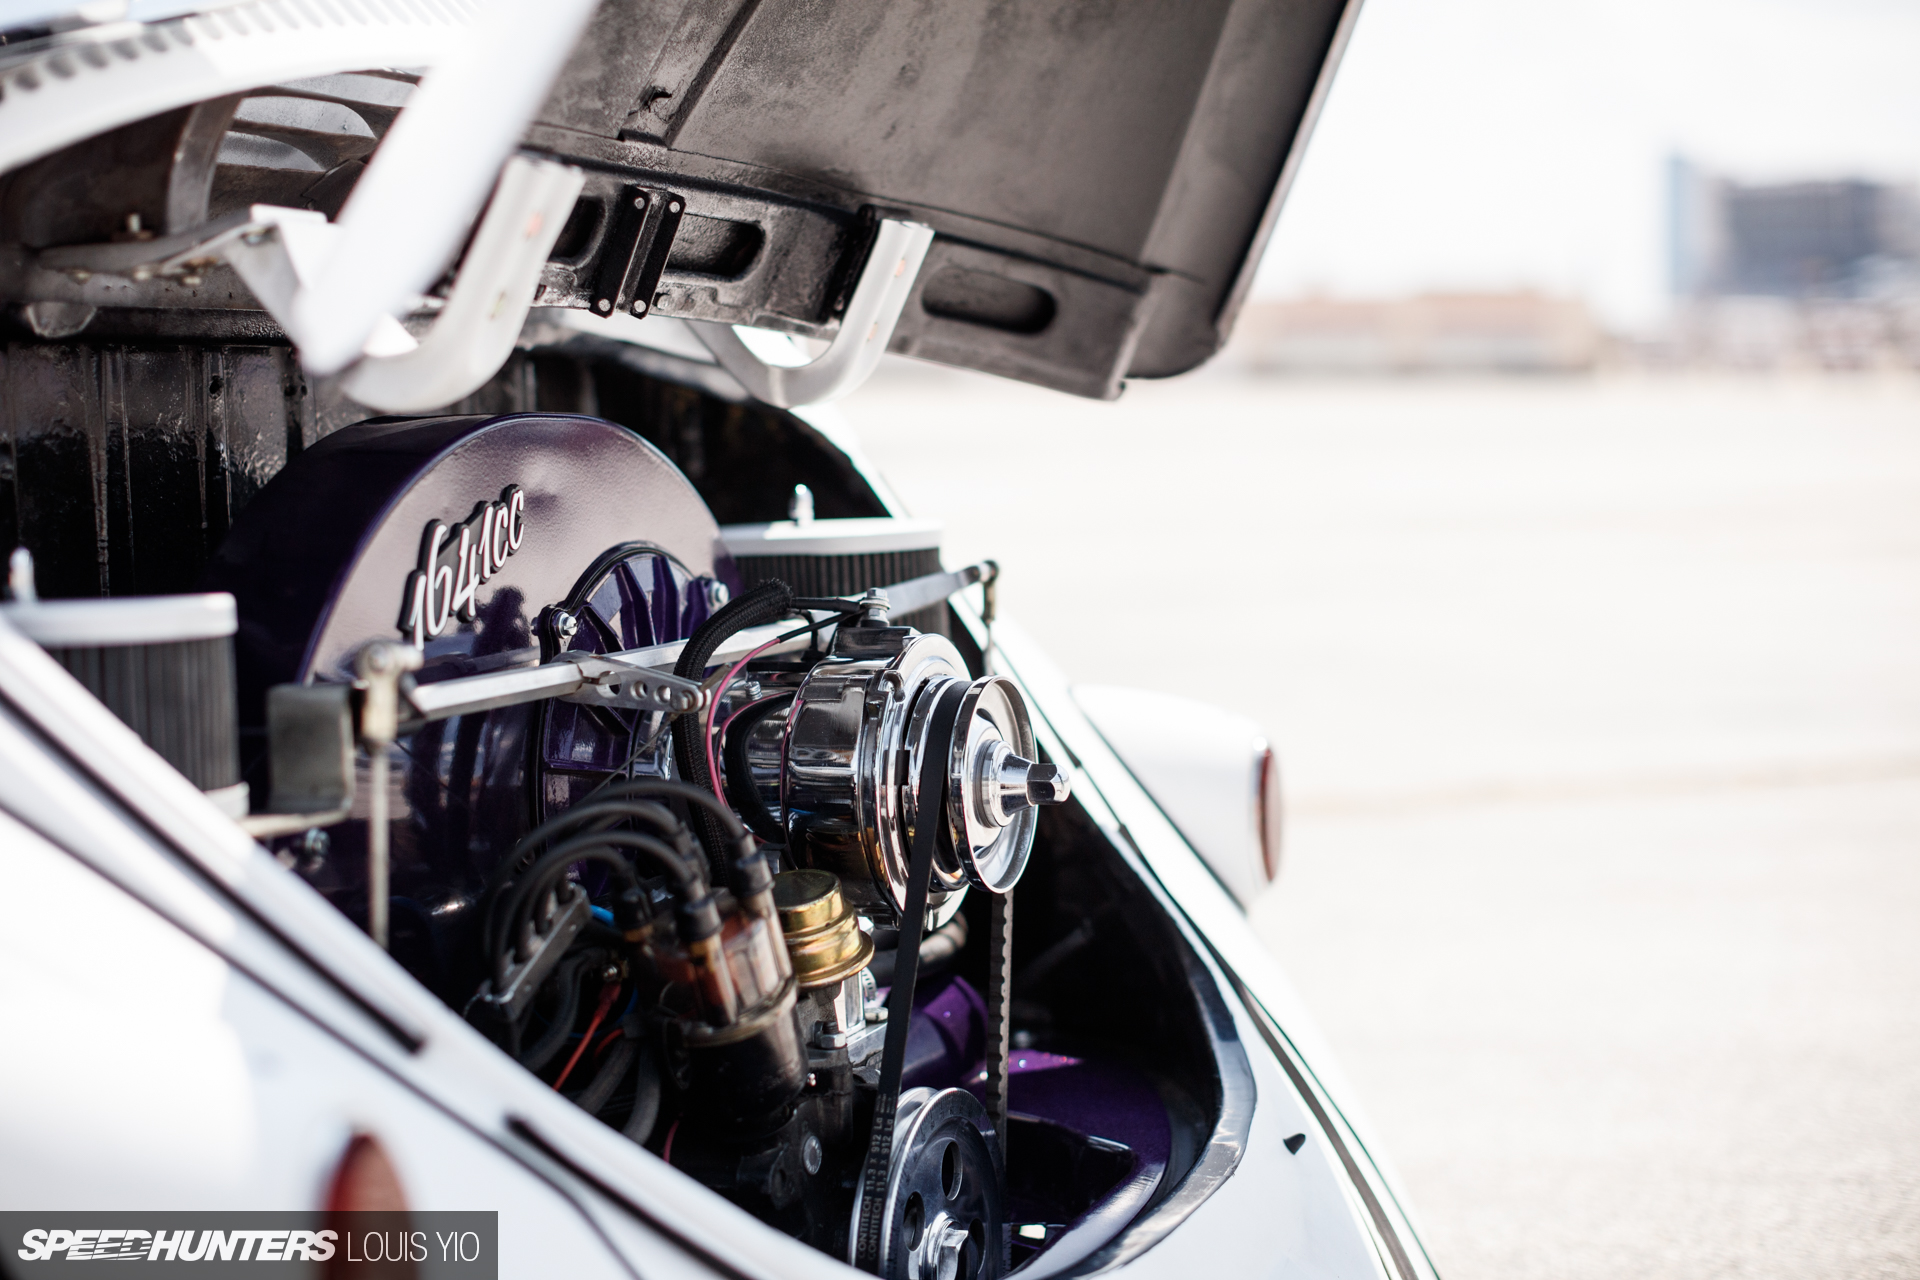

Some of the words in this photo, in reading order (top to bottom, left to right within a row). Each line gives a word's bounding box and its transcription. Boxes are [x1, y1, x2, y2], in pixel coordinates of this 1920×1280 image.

[858, 1196, 872, 1259] CONTITECH
[865, 1168, 877, 1191] 11.3
[871, 1134, 882, 1153] 912
[868, 1198, 882, 1260] CONTITECH
[881, 1135, 892, 1154] 912
